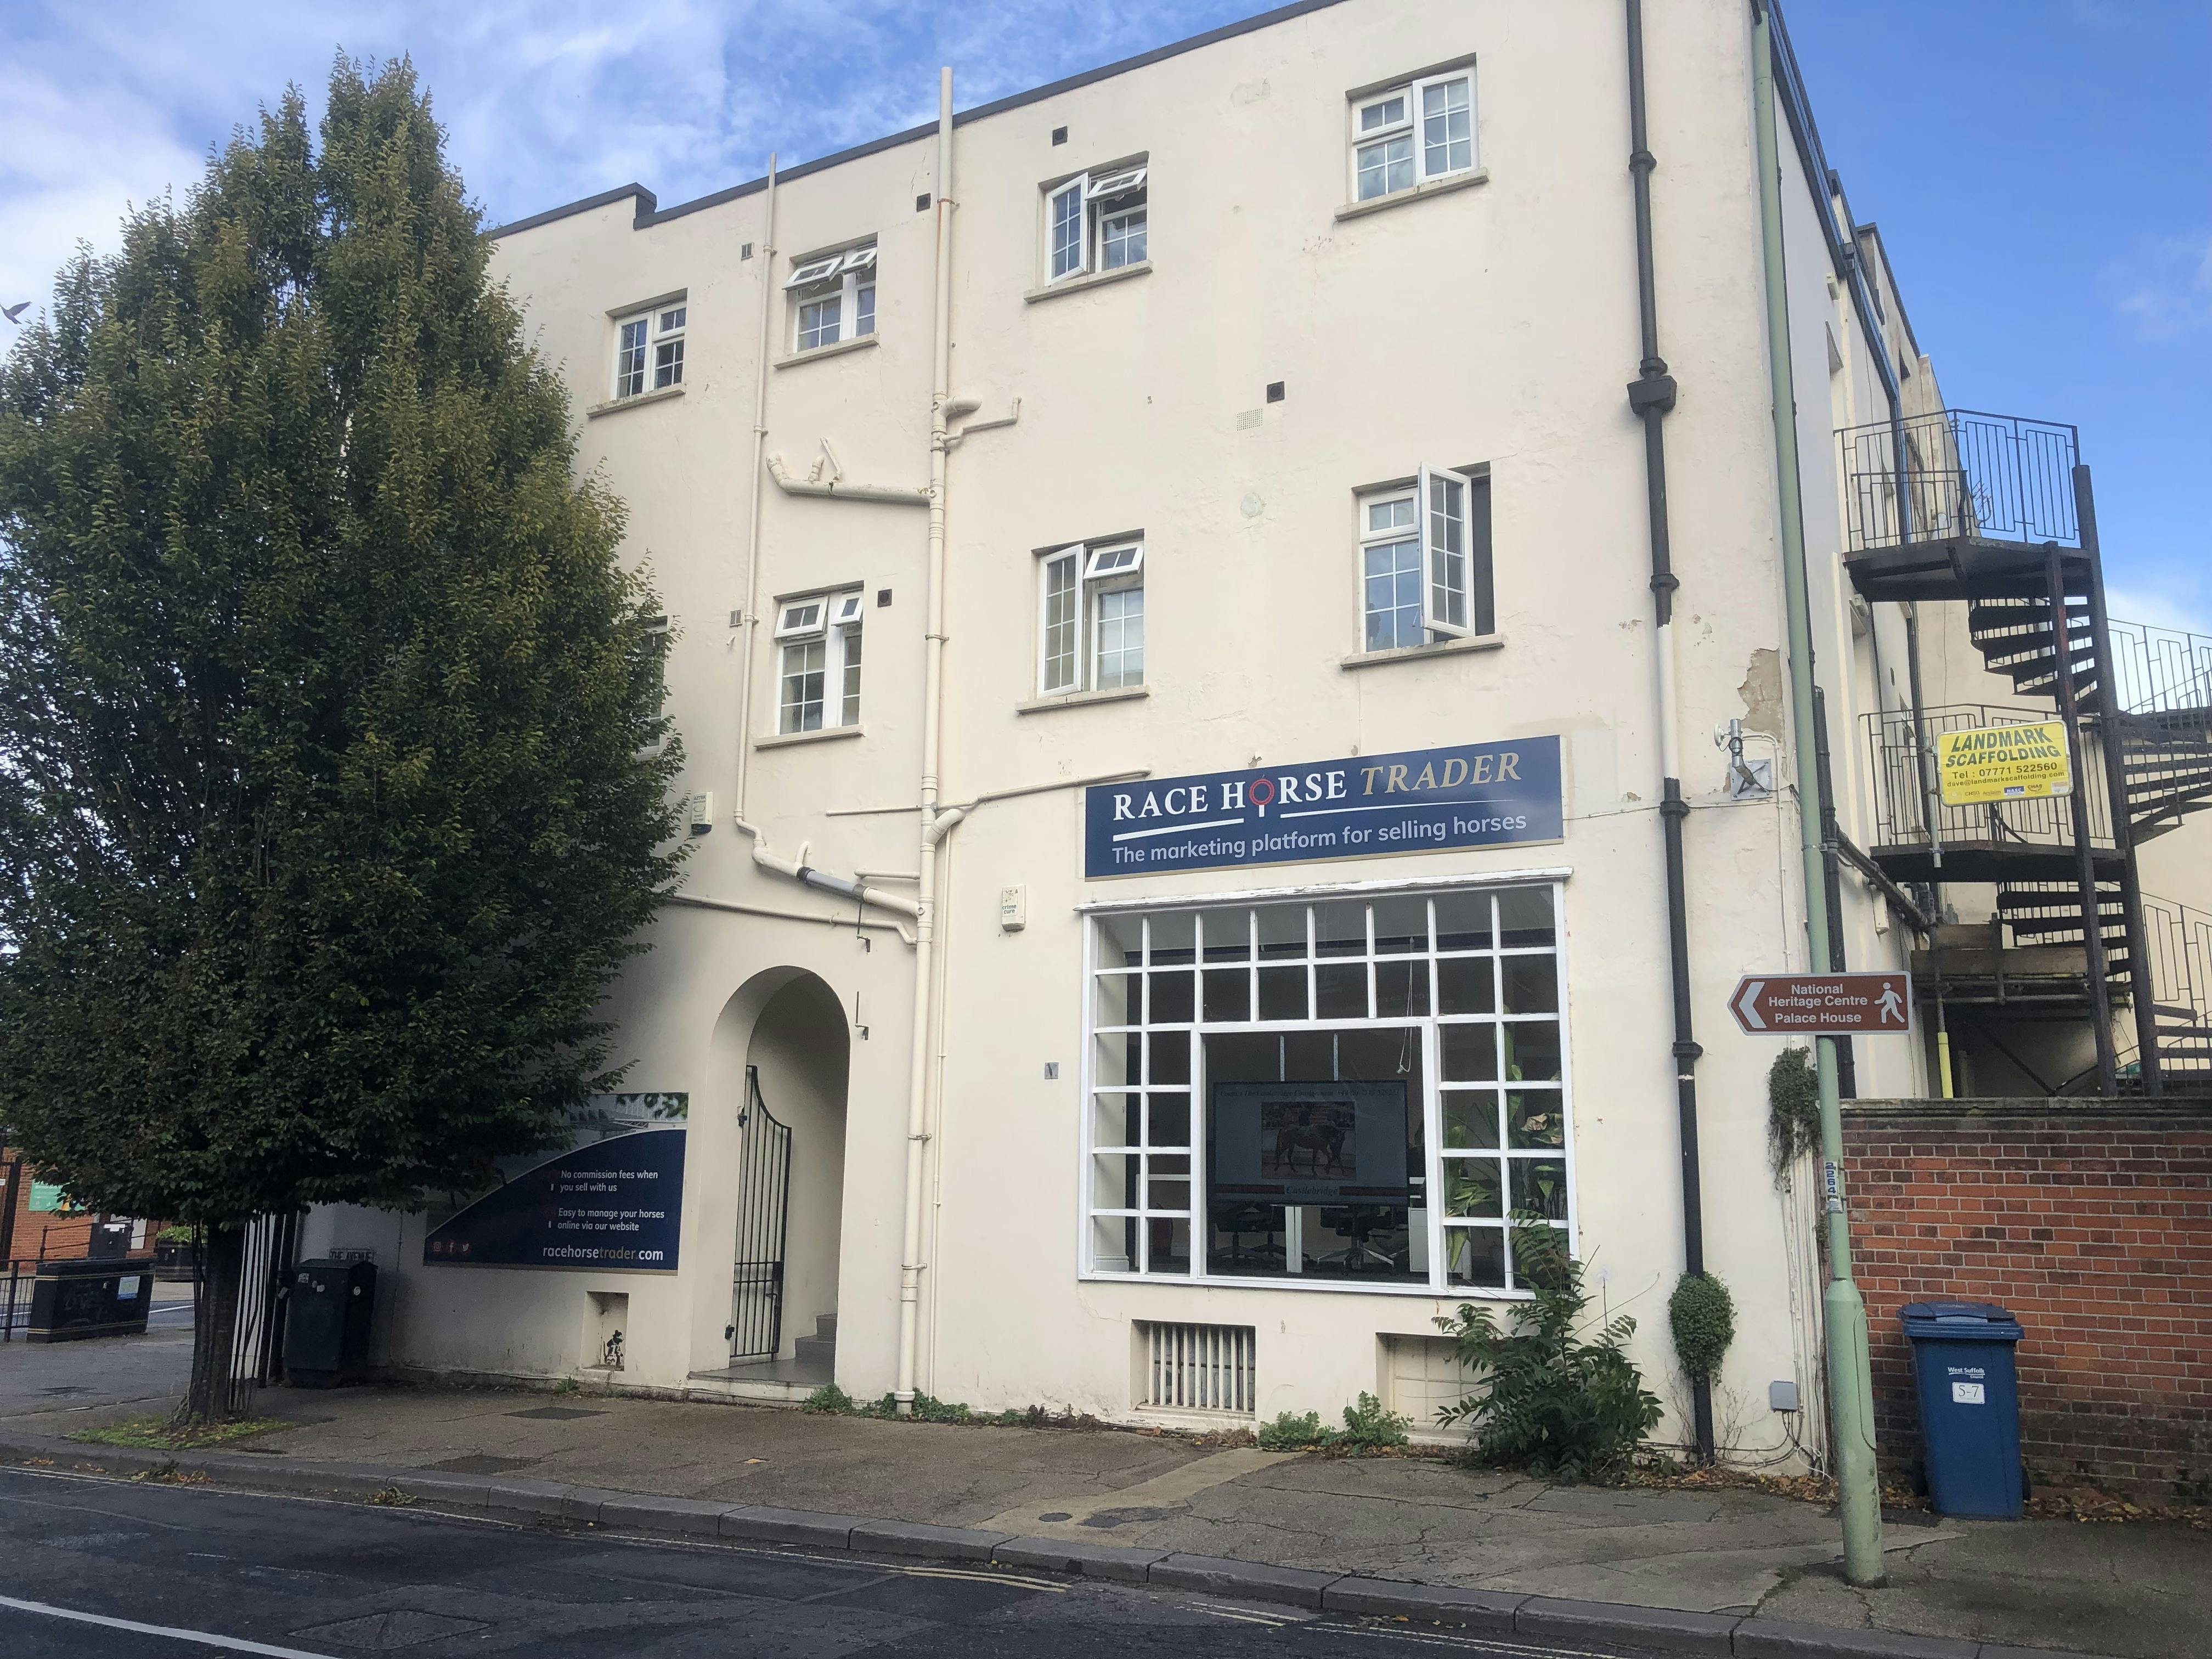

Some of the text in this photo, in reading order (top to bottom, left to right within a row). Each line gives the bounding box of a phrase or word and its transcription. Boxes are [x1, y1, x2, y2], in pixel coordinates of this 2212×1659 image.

[1951, 727, 2052, 752] LANDMARK
[1946, 745, 2061, 768] SCAFFOLDING
[1952, 771, 1968, 779] Tel
[1979, 767, 2011, 777] 07771
[2016, 762, 2057, 773] 522560
[1113, 752, 1522, 821] RACE HORSE TRADER
[1112, 813, 1527, 864] The marketing platform for selling horses
[1791, 984, 1843, 994] National
[1769, 995, 1867, 1008] Heritage Centre
[1775, 1012, 1861, 1023] Palace House
[561, 1170, 658, 1179] No commission fees when
[560, 1184, 573, 1193] you
[575, 1182, 588, 1192] sell
[590, 1182, 606, 1192] with
[558, 1208, 576, 1219] Easy
[619, 1211, 637, 1220] your
[639, 1209, 664, 1218] horses
[557, 1221, 580, 1230] online
[582, 1222, 592, 1230] via
[610, 1222, 639, 1231] website
[543, 1245, 664, 1261] racehorsetrader.com
